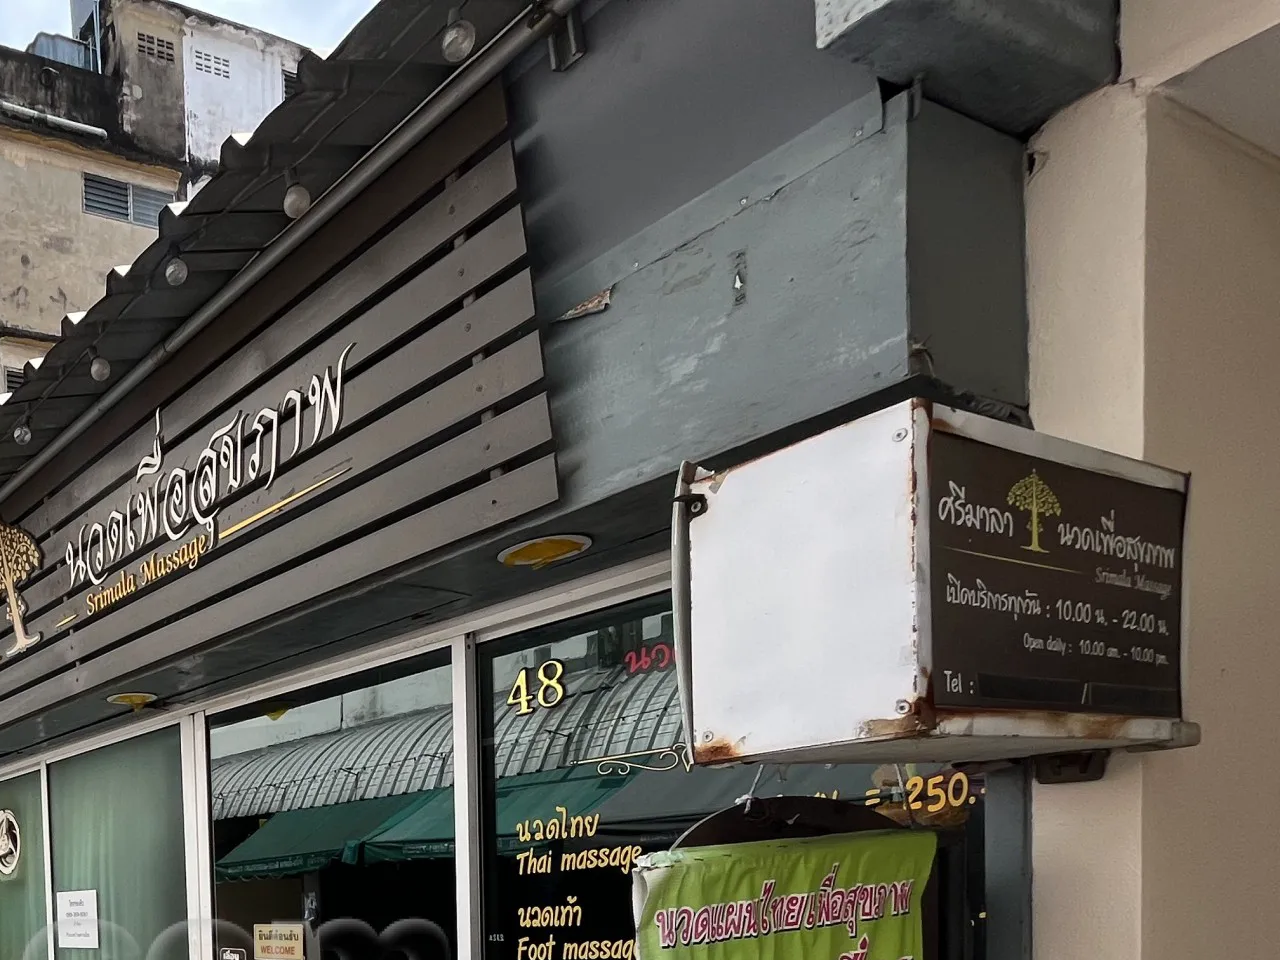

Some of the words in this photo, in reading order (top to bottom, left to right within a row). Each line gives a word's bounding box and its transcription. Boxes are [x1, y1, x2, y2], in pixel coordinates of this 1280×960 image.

[86, 572, 136, 616] Srimala
[140, 534, 209, 584] Massage
[946, 573, 1041, 621] เปิดบริการทุกวัน
[1056, 599, 1092, 624] 10.00
[1122, 609, 1155, 634] 22.00
[625, 642, 677, 674] นว
[1023, 632, 1044, 652] Open
[1079, 639, 1105, 656] 10.00
[1130, 646, 1154, 663] 10.00
[507, 659, 564, 716] 48
[944, 670, 962, 693] Tel
[516, 806, 600, 842] นวดไทย
[516, 847, 553, 876] Thai
[560, 844, 643, 875] massage
[517, 895, 582, 928] นวดเท้า
[261, 945, 296, 956] WELCOME
